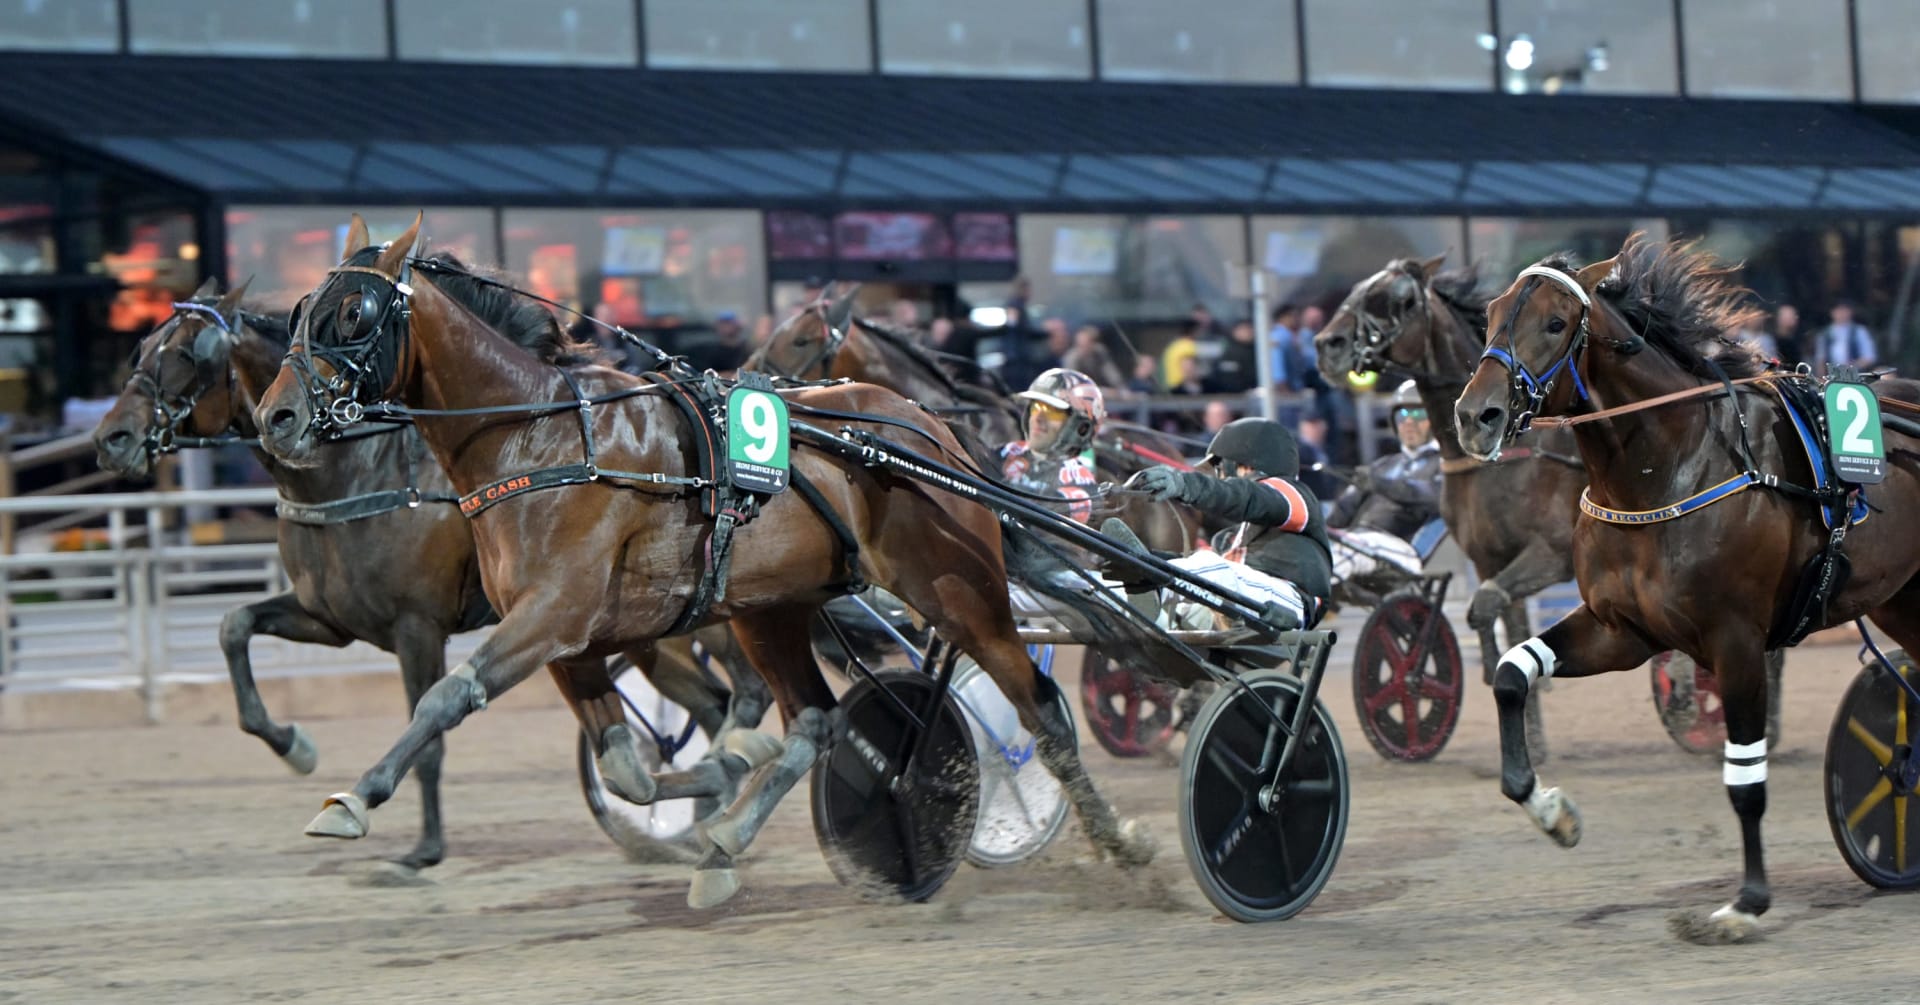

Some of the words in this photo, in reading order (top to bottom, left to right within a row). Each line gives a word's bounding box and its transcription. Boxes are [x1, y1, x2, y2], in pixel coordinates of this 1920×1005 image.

[741, 392, 778, 463] 9
[1836, 387, 1874, 454] 2
[486, 475, 532, 500] CASH
[889, 455, 915, 470] STALL
[916, 465, 952, 485] MATTIAS
